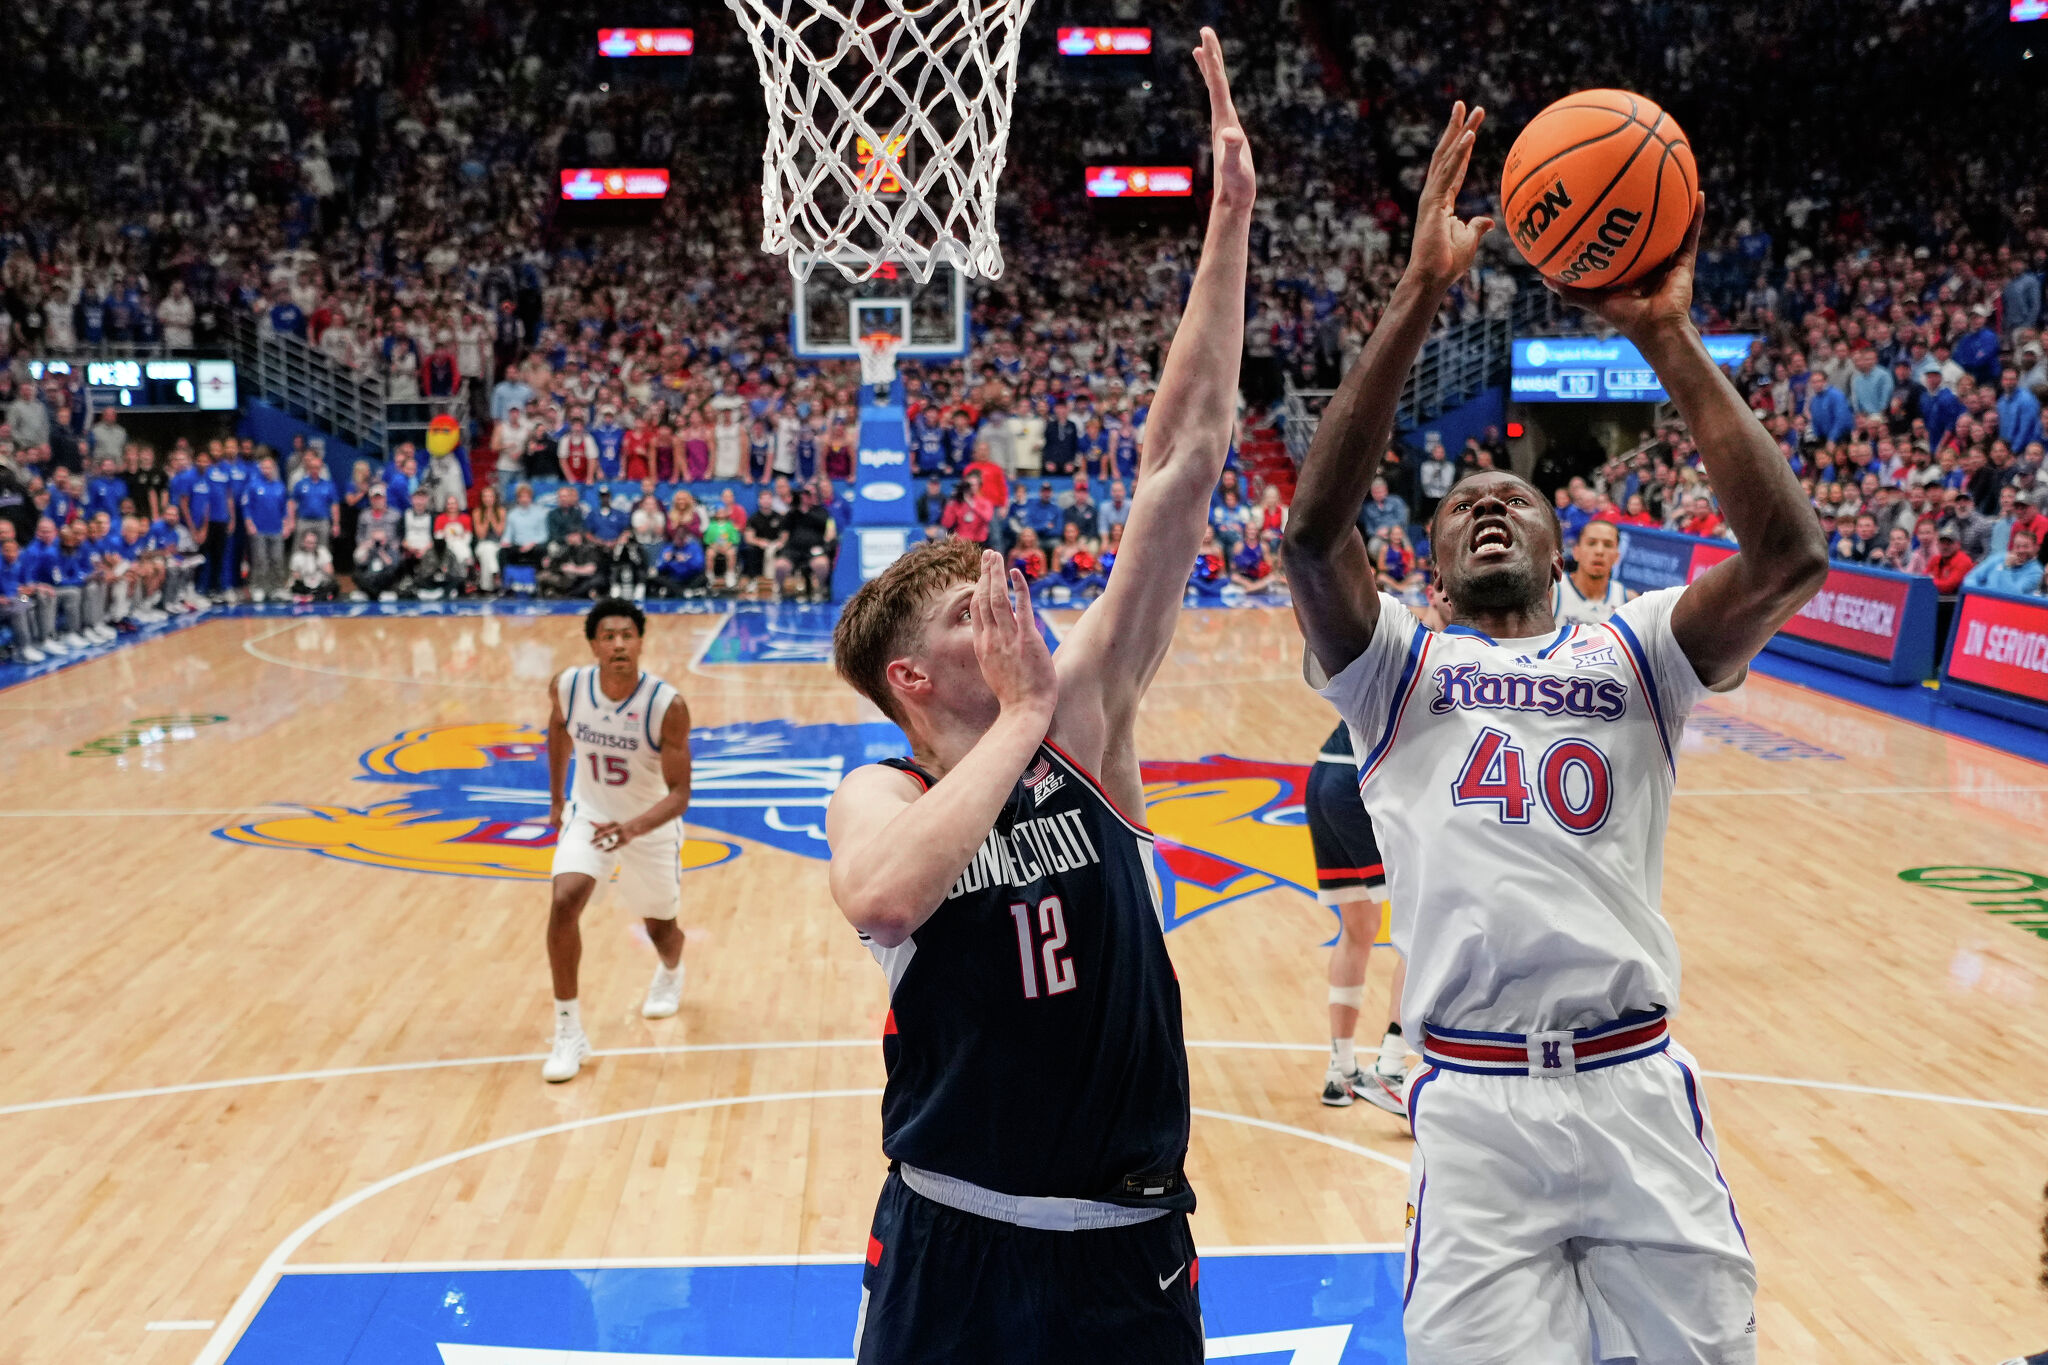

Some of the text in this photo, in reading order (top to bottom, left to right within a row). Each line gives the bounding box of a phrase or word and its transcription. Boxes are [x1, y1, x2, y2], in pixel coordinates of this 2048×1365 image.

[1514, 177, 1573, 252] NCAA
[1558, 206, 1644, 284] Wilso
[1567, 375, 1590, 394] 10
[1963, 619, 1987, 657] IN
[1430, 661, 1628, 722] Kansas
[576, 722, 639, 751] Kansas
[585, 752, 630, 787] 15
[1034, 771, 1055, 795] BIG
[1035, 774, 1065, 803] EAST
[1450, 726, 1614, 836] 40
[1010, 895, 1077, 999] 12
